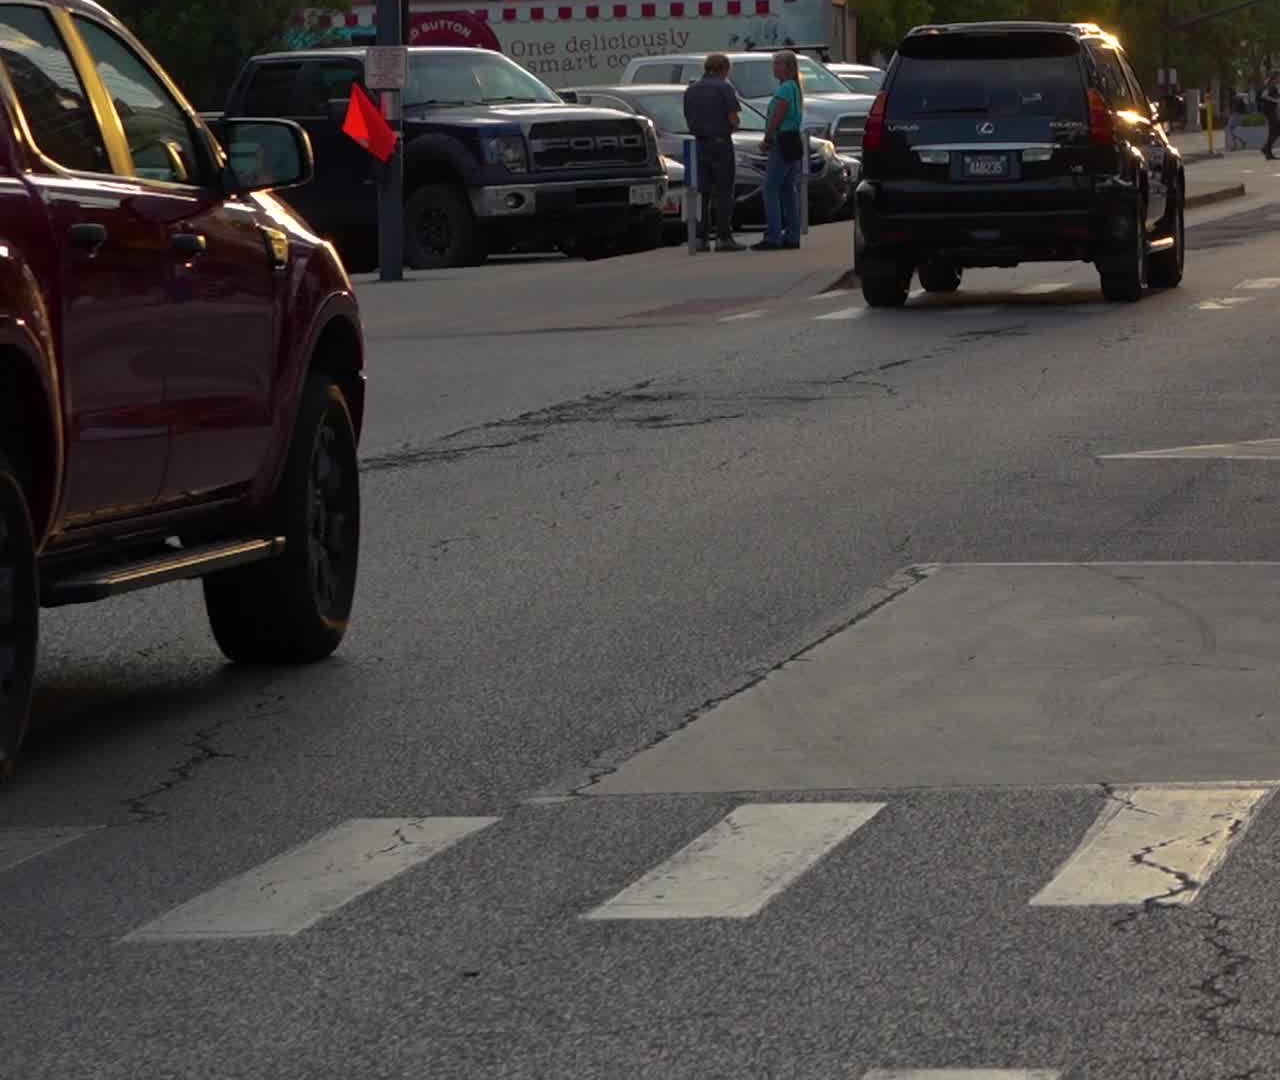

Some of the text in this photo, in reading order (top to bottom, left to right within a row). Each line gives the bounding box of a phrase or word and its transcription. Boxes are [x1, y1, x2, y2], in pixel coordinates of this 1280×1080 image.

[421, 18, 473, 40] BUTTON
[510, 27, 692, 58] One deliciously
[526, 53, 598, 74] smart
